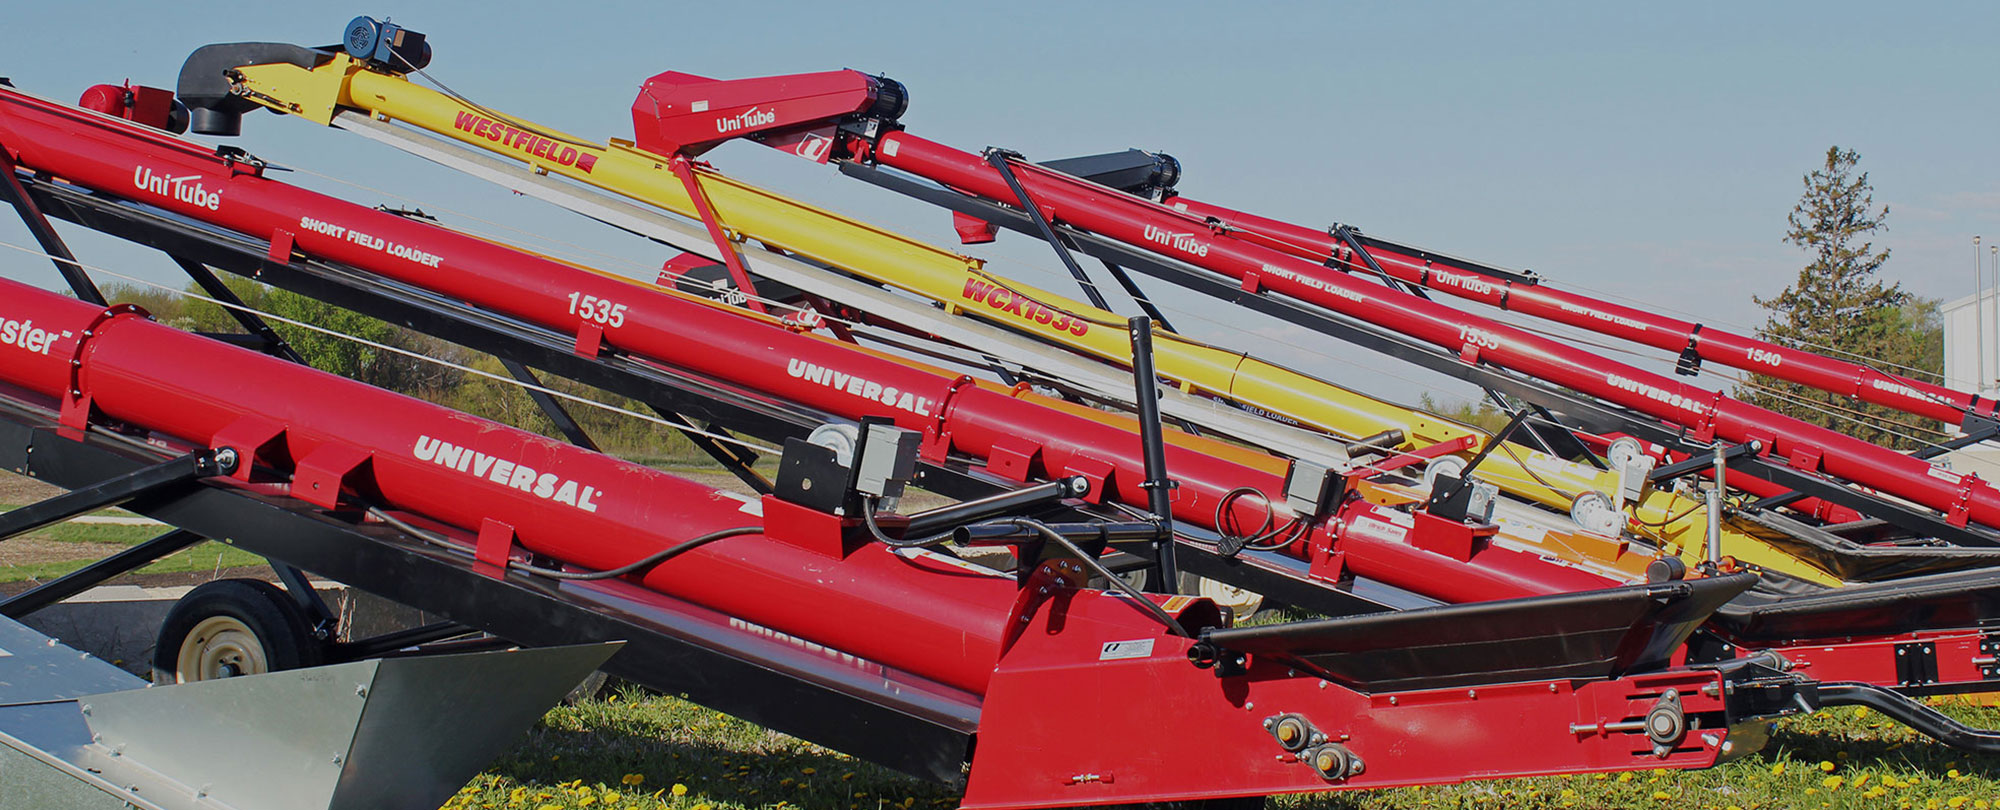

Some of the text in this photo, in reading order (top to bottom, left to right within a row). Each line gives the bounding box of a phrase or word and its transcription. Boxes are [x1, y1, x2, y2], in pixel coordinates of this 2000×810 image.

[454, 110, 578, 167] WESTFIELD
[716, 106, 776, 133] UniTube
[134, 165, 221, 211] UniTube
[300, 216, 442, 268] SHORT FIELD LOADER
[1143, 224, 1209, 258] UniTube
[1262, 263, 1363, 303] SHORT FIELD LOADER
[568, 291, 628, 328] 1535
[962, 277, 1089, 337] WCX1535
[0, 316, 60, 356] ster
[1458, 324, 1500, 350] 1535
[1746, 347, 1782, 367] 1540
[787, 357, 931, 417] UNIVERSAL
[1606, 373, 1704, 414] UNIVERSAL
[413, 434, 600, 513] UNIVERSAL
